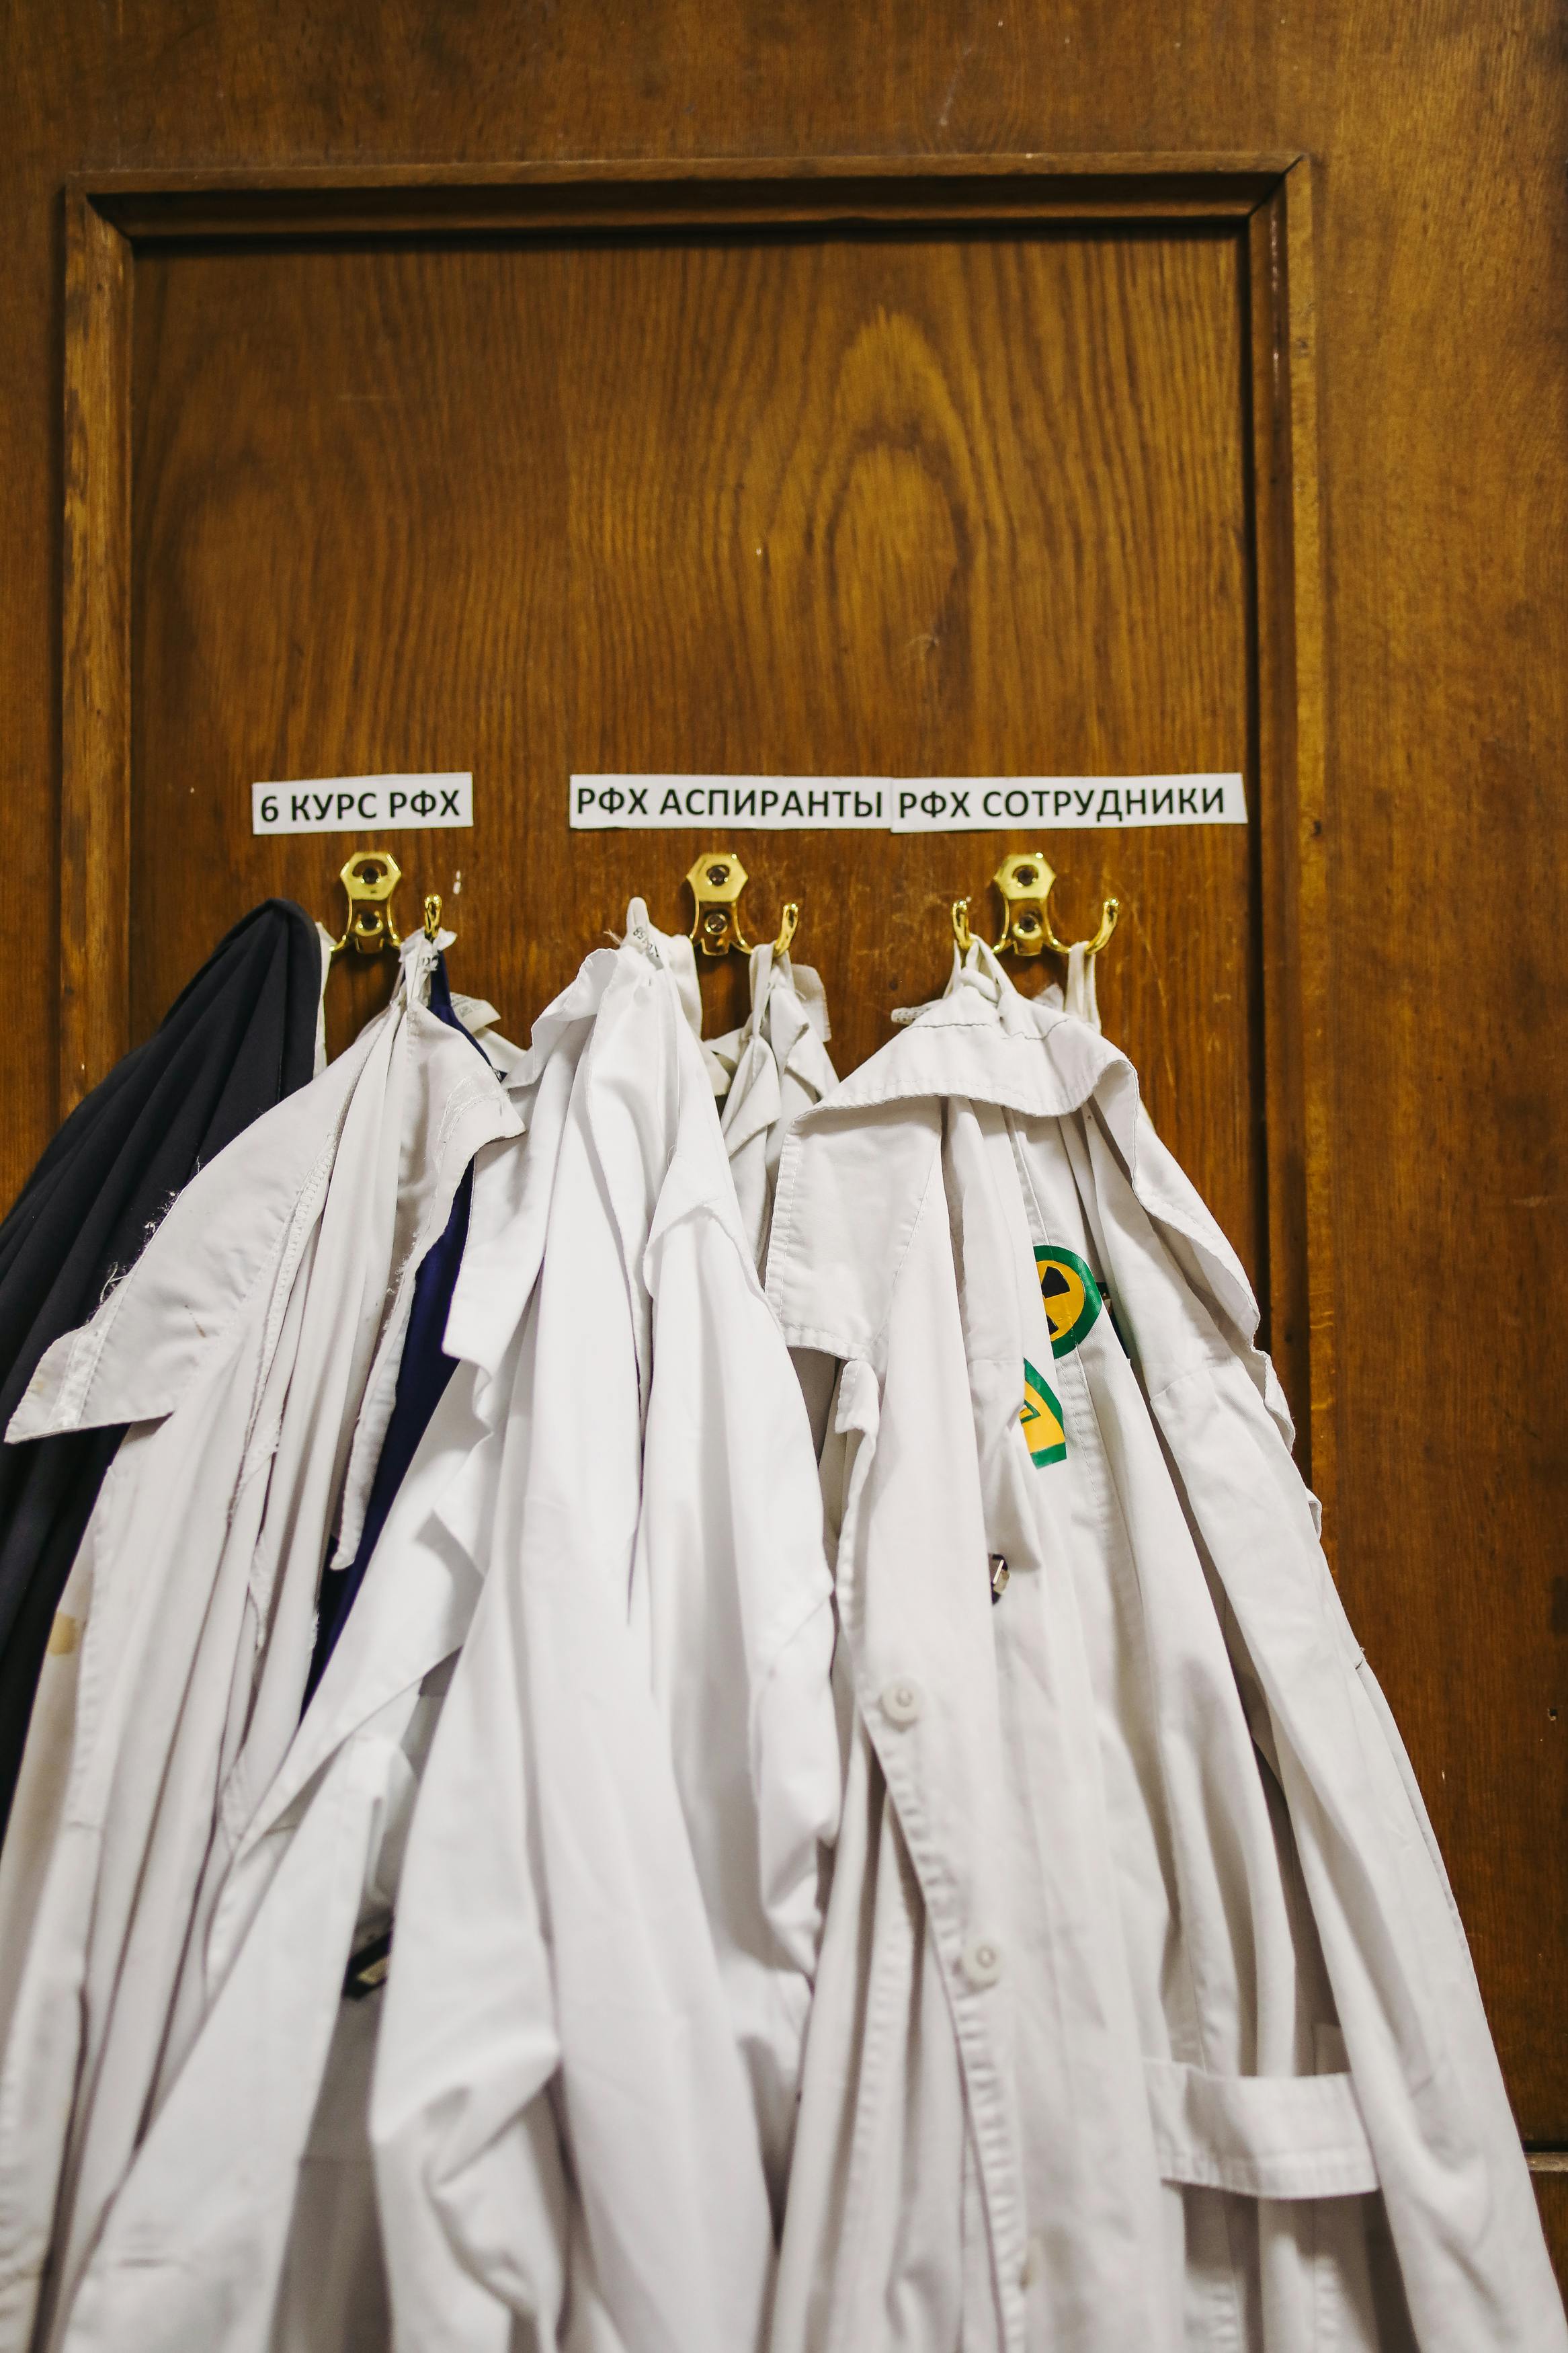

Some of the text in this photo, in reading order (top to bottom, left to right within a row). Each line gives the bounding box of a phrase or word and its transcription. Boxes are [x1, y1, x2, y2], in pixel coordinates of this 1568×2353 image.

[261, 790, 460, 823] 6 КУРС РФХ
[577, 787, 882, 818] РФХ АСПИРАНТЫ
[899, 787, 1225, 822] РФХ СОТРУДНИКИ
